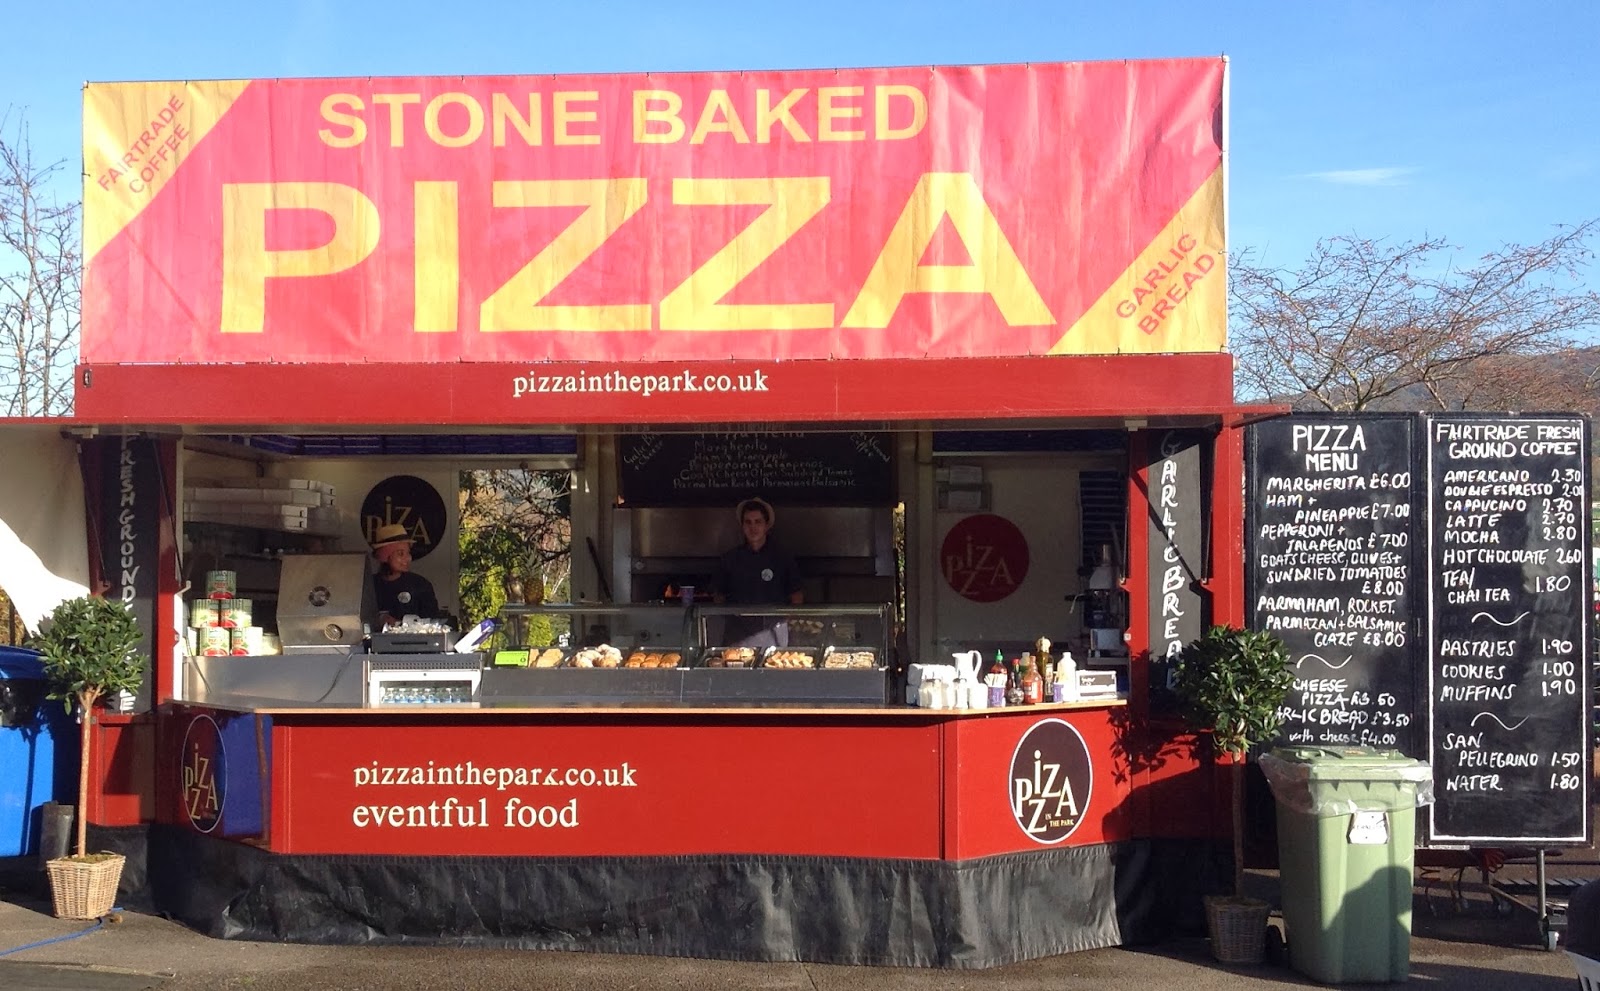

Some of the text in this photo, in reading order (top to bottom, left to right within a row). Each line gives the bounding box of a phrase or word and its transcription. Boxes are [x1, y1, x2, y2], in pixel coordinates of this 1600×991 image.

[318, 84, 928, 149] STONE BAKED
[97, 94, 184, 192] FAIRTRADE
[128, 123, 190, 193] COFFEE
[220, 171, 1057, 333] PIZZA
[1116, 234, 1197, 319] GARLIC
[1137, 254, 1215, 336] BREAD
[512, 369, 769, 398] pizzainthepark.co.uk
[1292, 424, 1366, 452] PIZZA
[1436, 423, 1581, 442] FAIRTRADE FRESH
[1449, 441, 1578, 459] GROUND COFFEE
[1305, 452, 1358, 471] MENU
[1266, 472, 1411, 492] MARGHERITA £6.00
[1443, 468, 1581, 483] AMERICANO 2.30
[1444, 484, 1493, 497] DOUBLE
[1493, 483, 1554, 497] ESPRESSO
[1265, 494, 1303, 508] HAM
[1444, 497, 1573, 514] CAPPUCINO 2.70
[1295, 502, 1410, 524] PINEAPPLE £7.00
[1446, 512, 1575, 529] LATTE 2.70
[1260, 523, 1334, 540] PEPPERONI
[1444, 526, 1577, 544] MOCHA 2.80
[119, 508, 140, 602] GROUND
[1285, 537, 1364, 554] JALAPENOS
[1260, 553, 1298, 568] GOATS
[1443, 549, 1477, 566] HOT
[1477, 548, 1549, 565] CHOCOLATE
[1266, 565, 1407, 584] SUNDRIED TOMATOES
[1535, 575, 1571, 593] 1.80
[1361, 581, 1404, 596] £8.00
[1448, 588, 1511, 604] CHAI TEA
[1314, 632, 1405, 648] GLAZE £8.00
[1440, 638, 1573, 658] PASTRIES 1.90
[1442, 660, 1575, 680] COOKIES 1.00
[1292, 677, 1348, 692] CHEESE
[1440, 678, 1576, 702] MUFFINS 1.90
[1301, 691, 1350, 711] PIZZA
[1274, 705, 1317, 724] ARLIC
[1319, 708, 1369, 731] BREAD
[1442, 732, 1484, 750] SAN
[1458, 750, 1580, 768] PELLEGRINO 1.50
[353, 760, 638, 790] pizzainthepark.co.uk
[1446, 773, 1580, 792] WATER 1.80
[352, 797, 580, 828] eventful food
[1060, 818, 1075, 826] PARK
